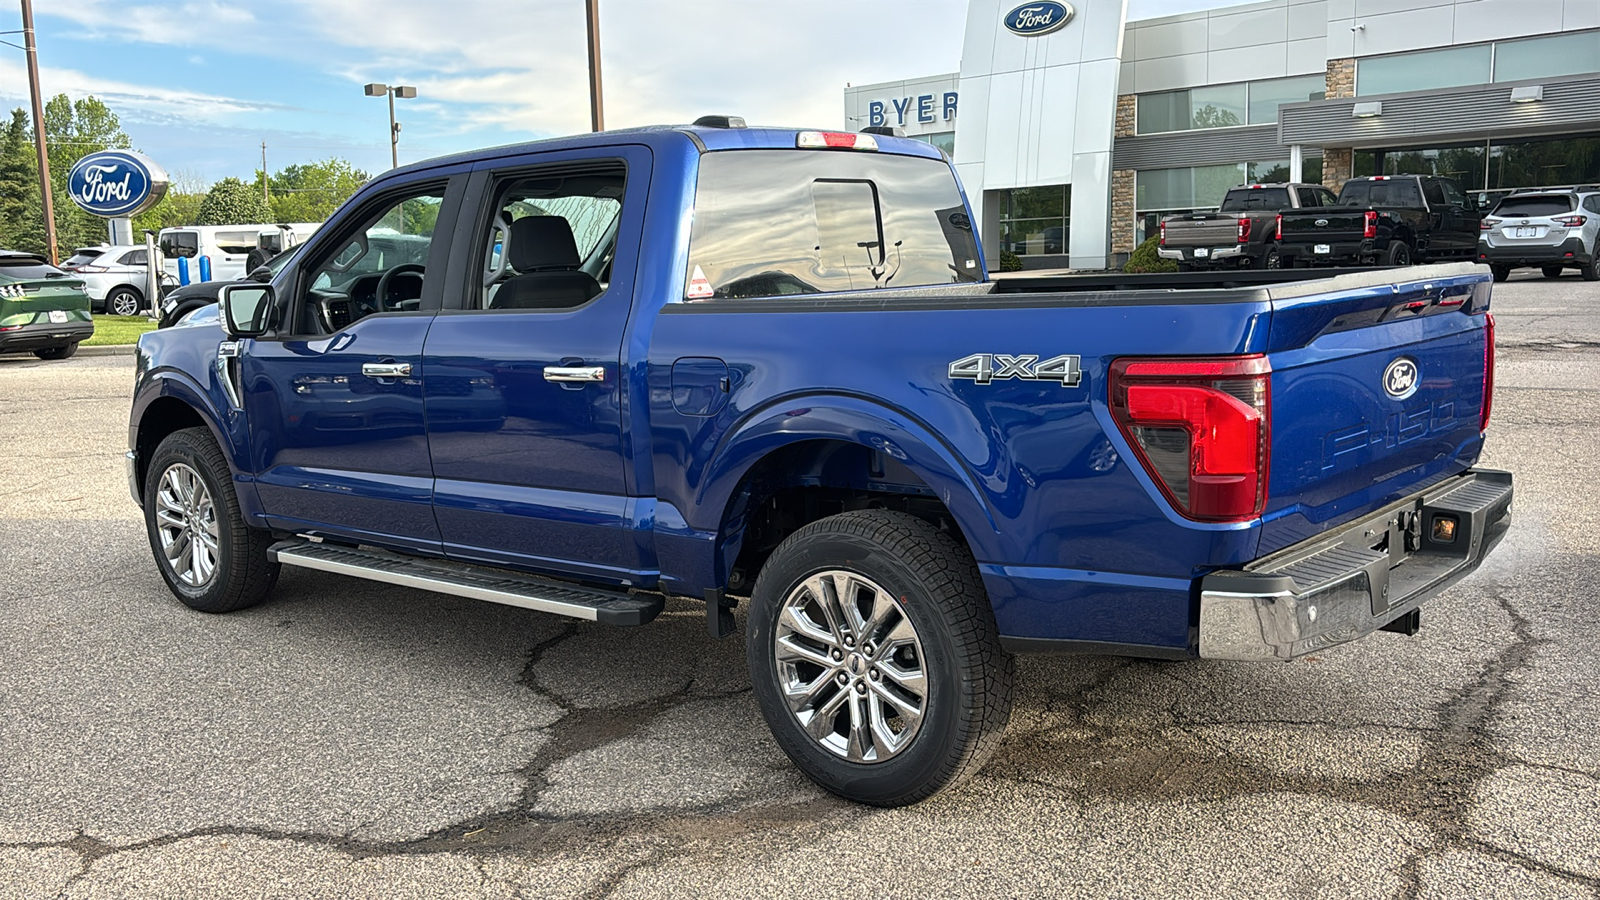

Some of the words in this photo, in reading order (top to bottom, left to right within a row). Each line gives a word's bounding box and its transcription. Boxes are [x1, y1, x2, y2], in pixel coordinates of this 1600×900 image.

[1015, 6, 1053, 29] Ford
[868, 91, 959, 127] BYER
[82, 165, 131, 203] Ford
[1391, 365, 1412, 390] Ford
[1321, 396, 1459, 470] F-150
